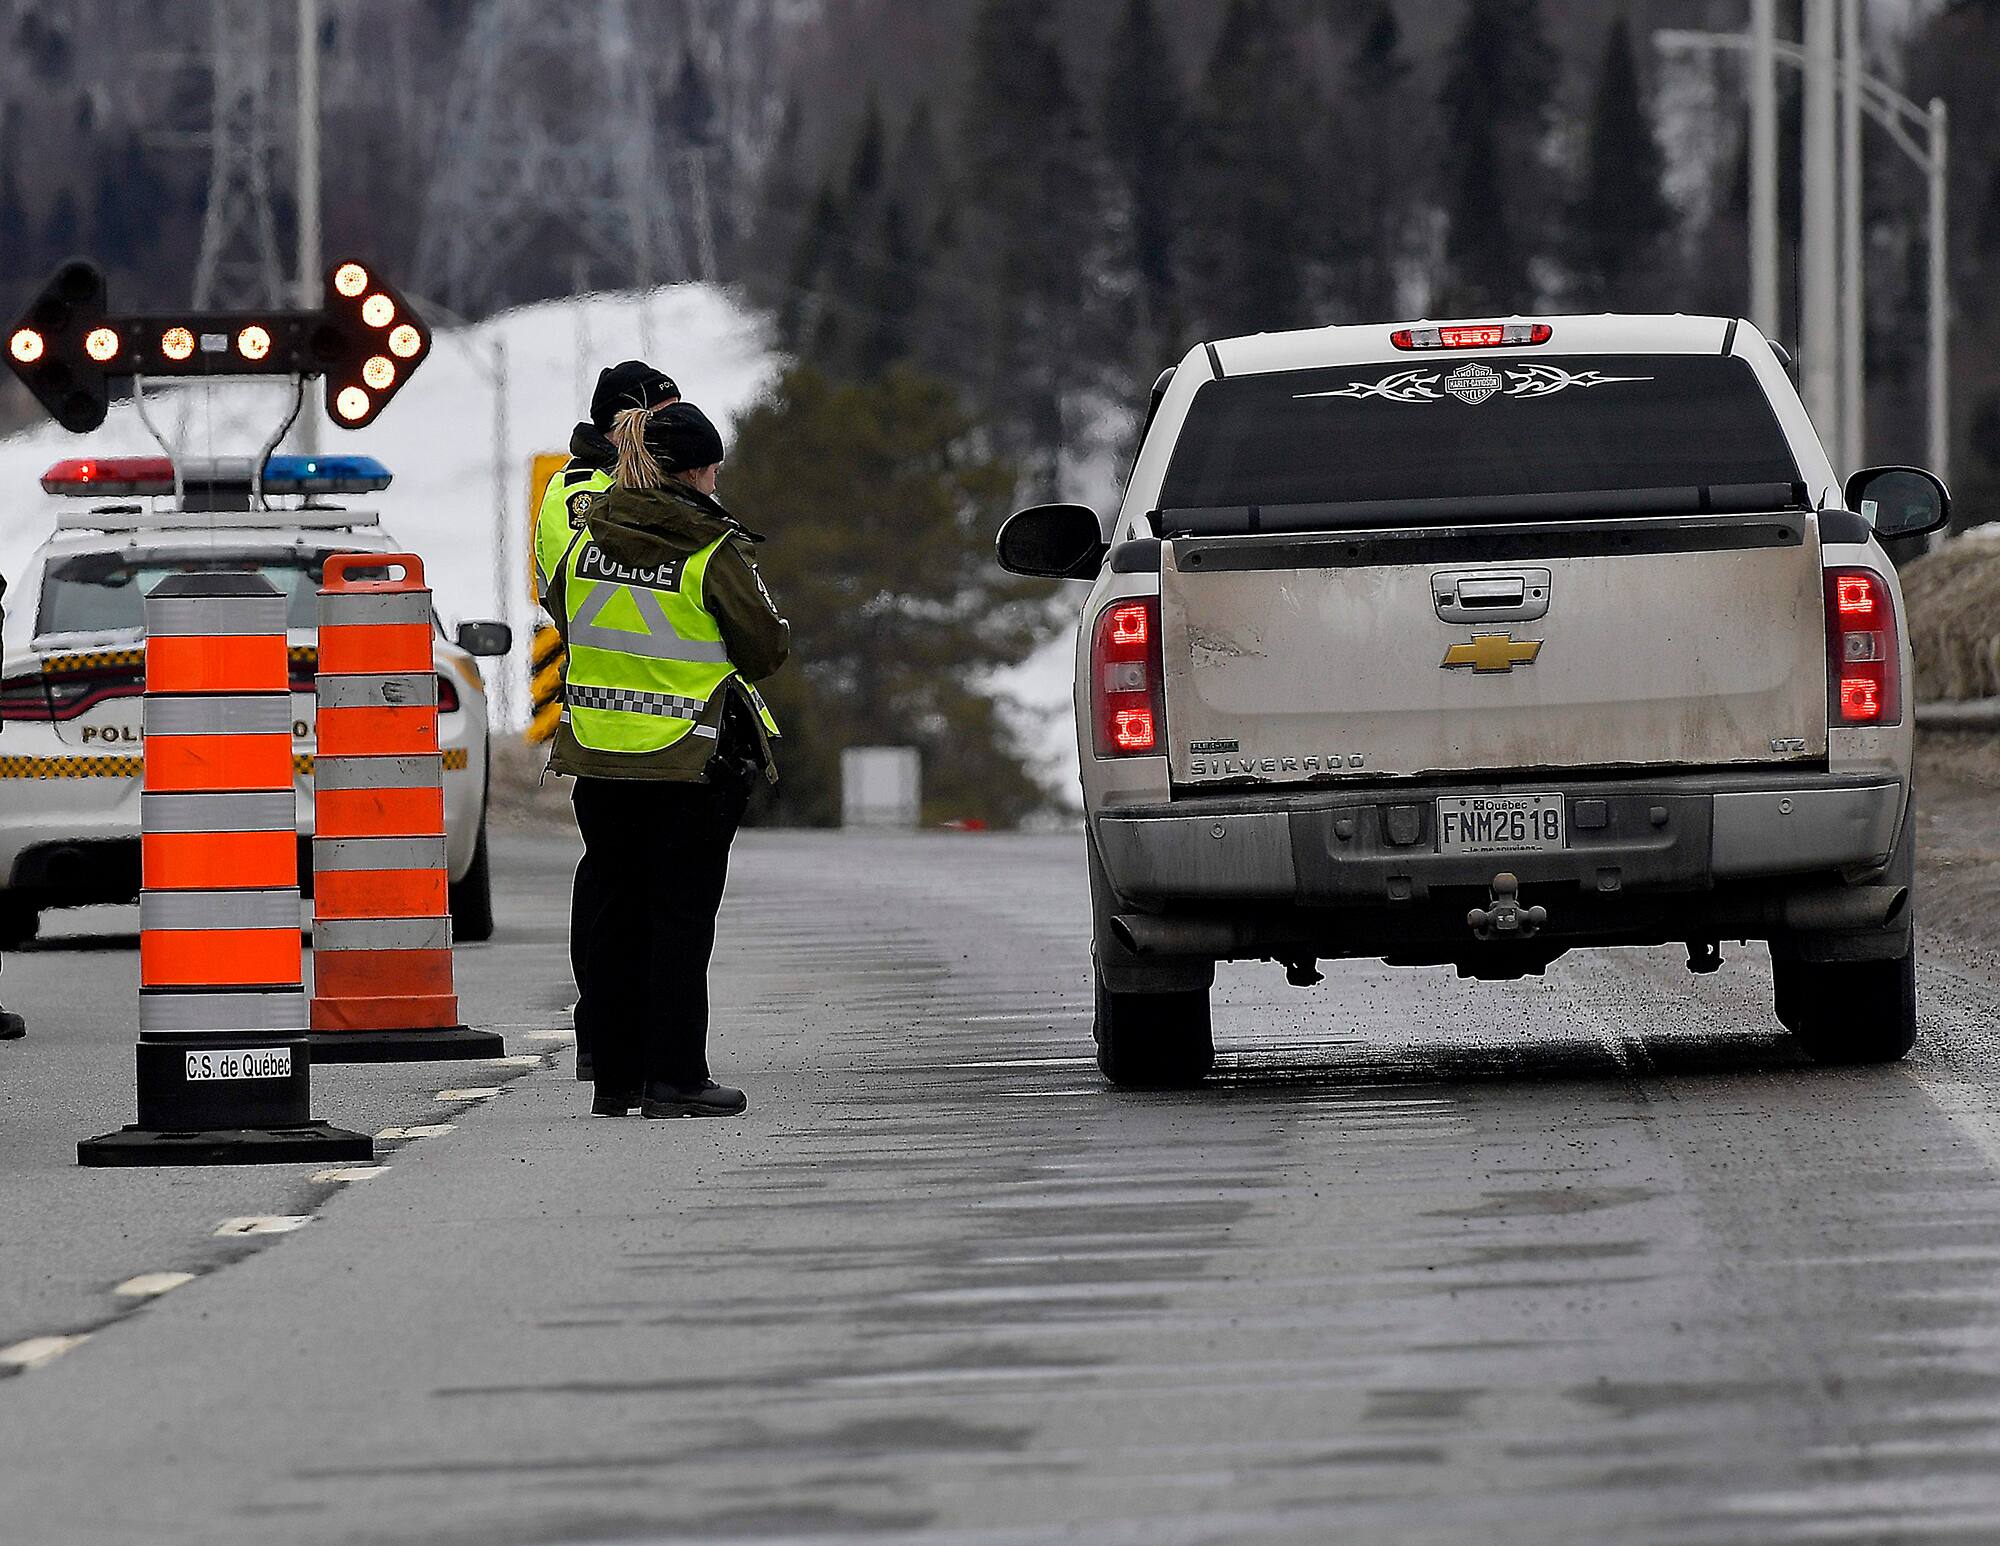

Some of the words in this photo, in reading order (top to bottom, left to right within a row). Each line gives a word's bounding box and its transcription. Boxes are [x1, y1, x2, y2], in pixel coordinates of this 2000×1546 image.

[1460, 368, 1486, 377] MOTOR
[658, 381, 674, 391] PO
[1461, 389, 1487, 400] CYCLES
[1770, 737, 1805, 752] LTZ
[1191, 753, 1365, 775] SILVERADO
[1485, 800, 1528, 810] Québec
[1443, 809, 1559, 844] FNM2618
[187, 1055, 216, 1079] C.S.
[220, 1055, 239, 1077] de
[242, 1052, 290, 1077] Québec
